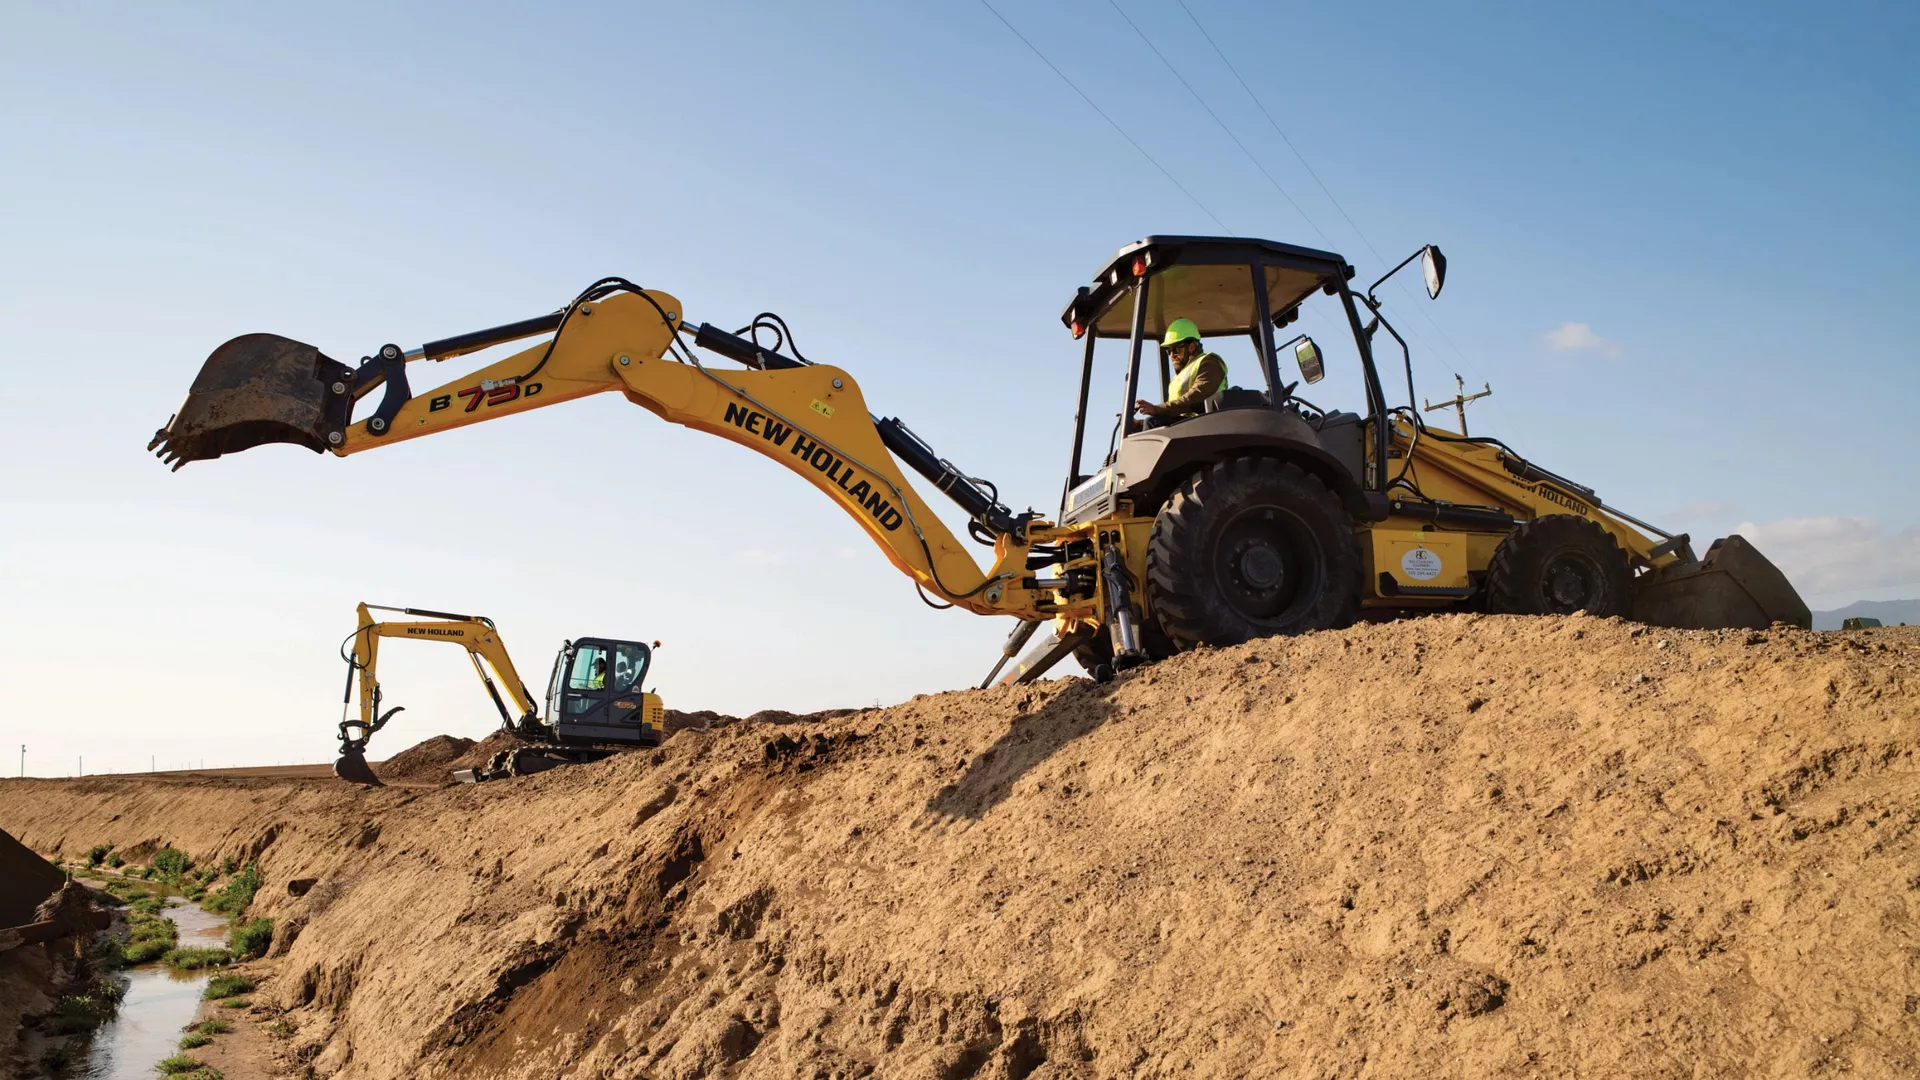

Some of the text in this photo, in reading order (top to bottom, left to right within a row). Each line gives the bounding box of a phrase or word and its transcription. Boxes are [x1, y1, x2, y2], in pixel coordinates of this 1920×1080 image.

[723, 402, 903, 532] NEW HOLLAND
[1538, 486, 1588, 516] HOLLAND
[407, 627, 464, 637] NEW HOLLAND
